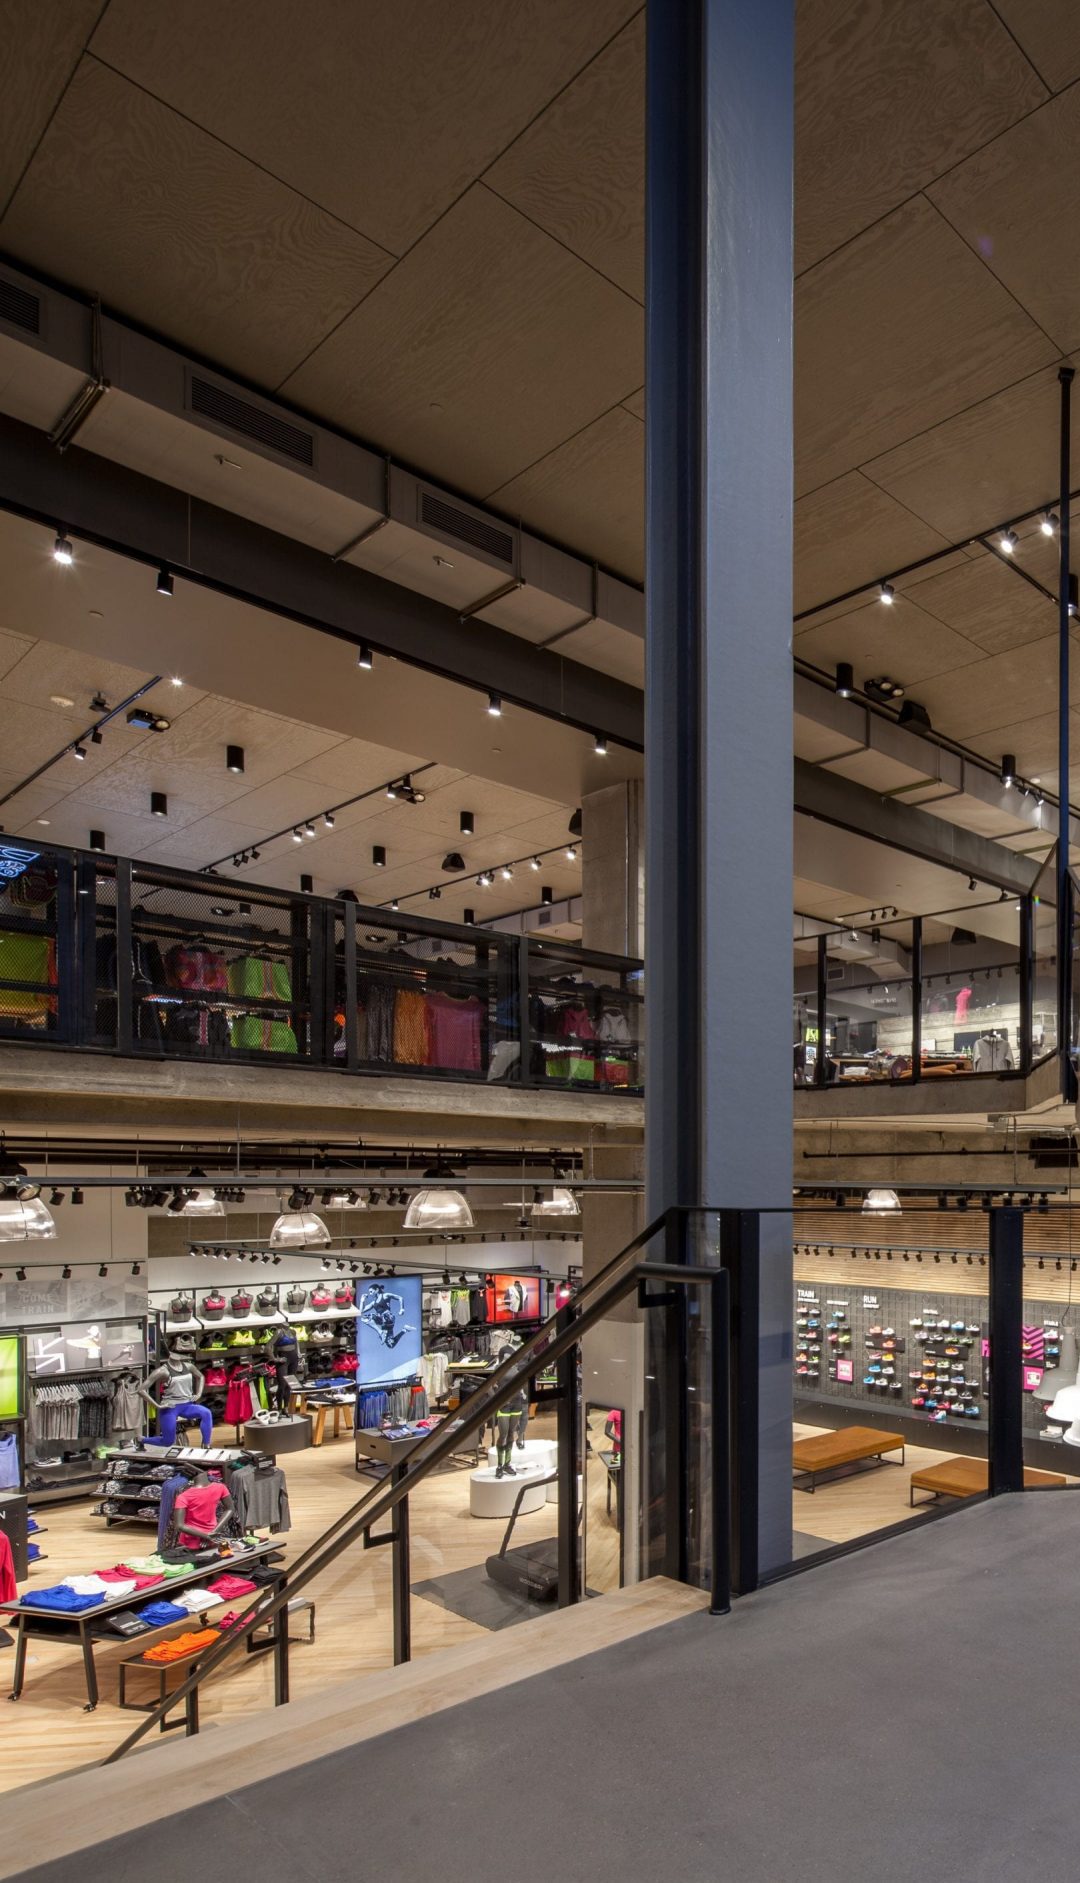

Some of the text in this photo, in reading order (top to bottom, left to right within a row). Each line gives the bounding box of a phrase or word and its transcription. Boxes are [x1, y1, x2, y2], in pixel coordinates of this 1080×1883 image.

[797, 1289, 815, 1299] TRAIN
[863, 1295, 877, 1304] RUN
[21, 1304, 54, 1315] TRAIN
